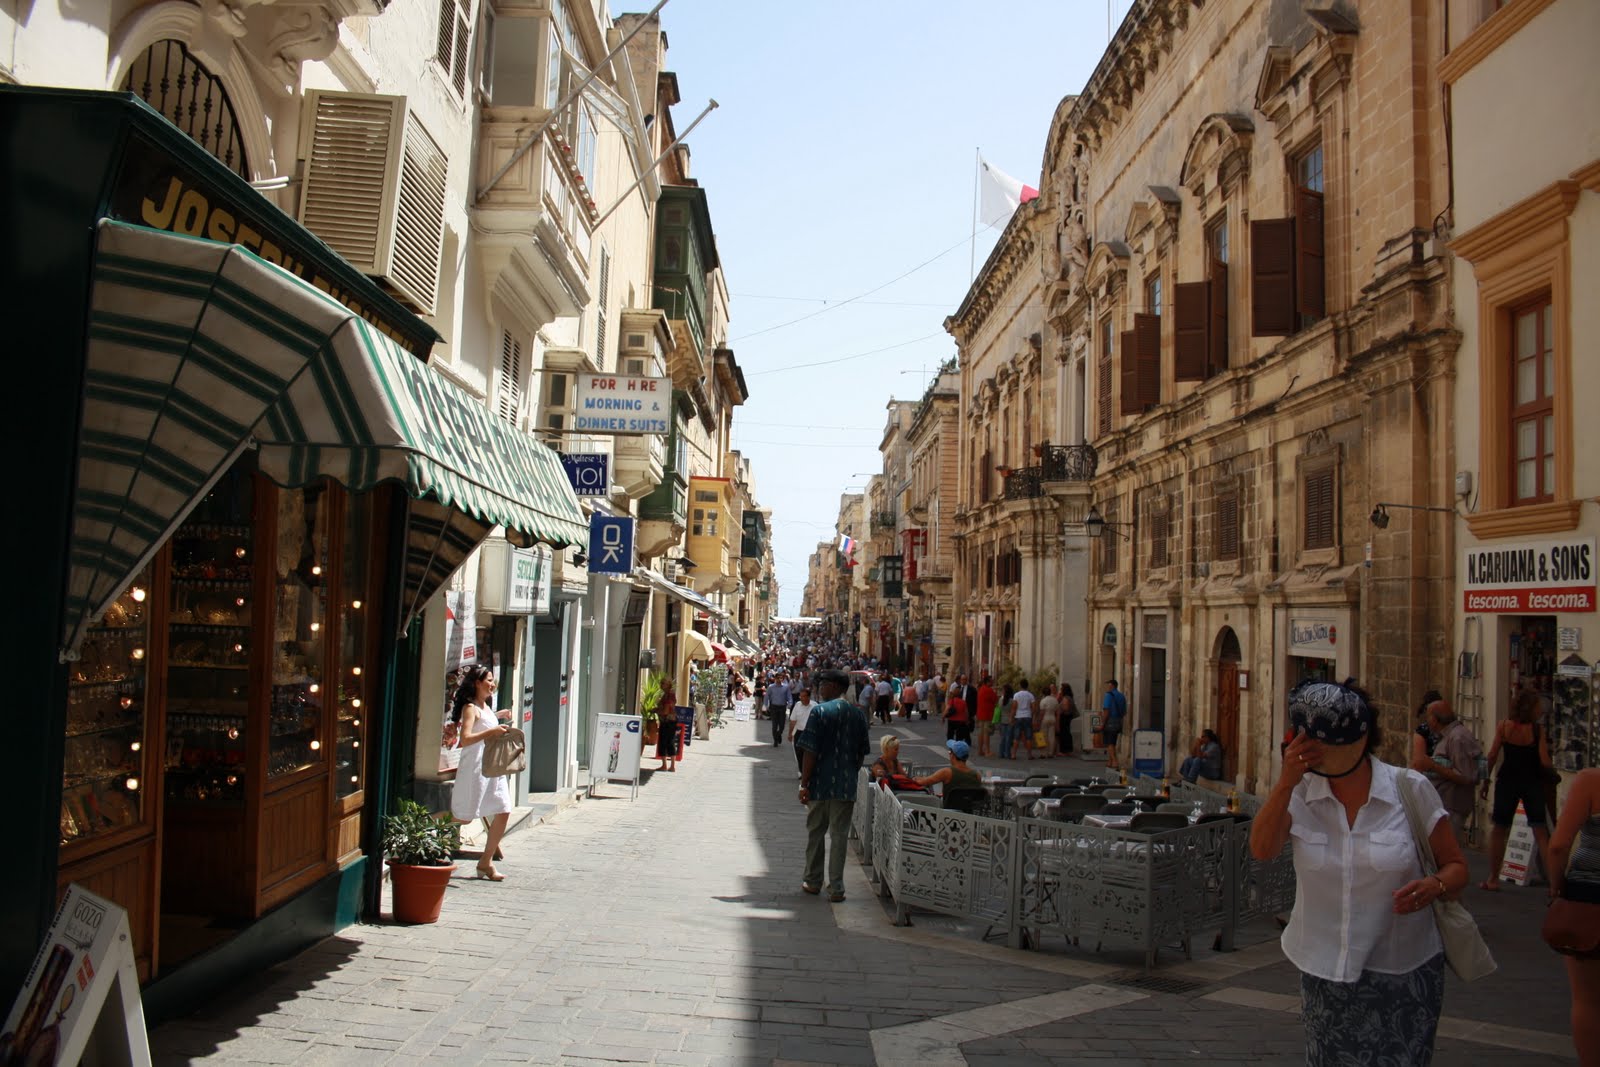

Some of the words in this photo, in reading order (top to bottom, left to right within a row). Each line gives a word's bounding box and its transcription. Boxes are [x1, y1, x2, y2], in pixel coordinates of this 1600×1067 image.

[591, 378, 616, 390] FOR
[627, 380, 657, 391] HRE
[585, 398, 642, 411] MORNING
[652, 402, 660, 411] &
[578, 417, 626, 431] DINNER
[629, 419, 666, 431] SUITS
[1538, 553, 1549, 582] &
[1551, 544, 1590, 581] SONS
[74, 902, 102, 929] GOZO
